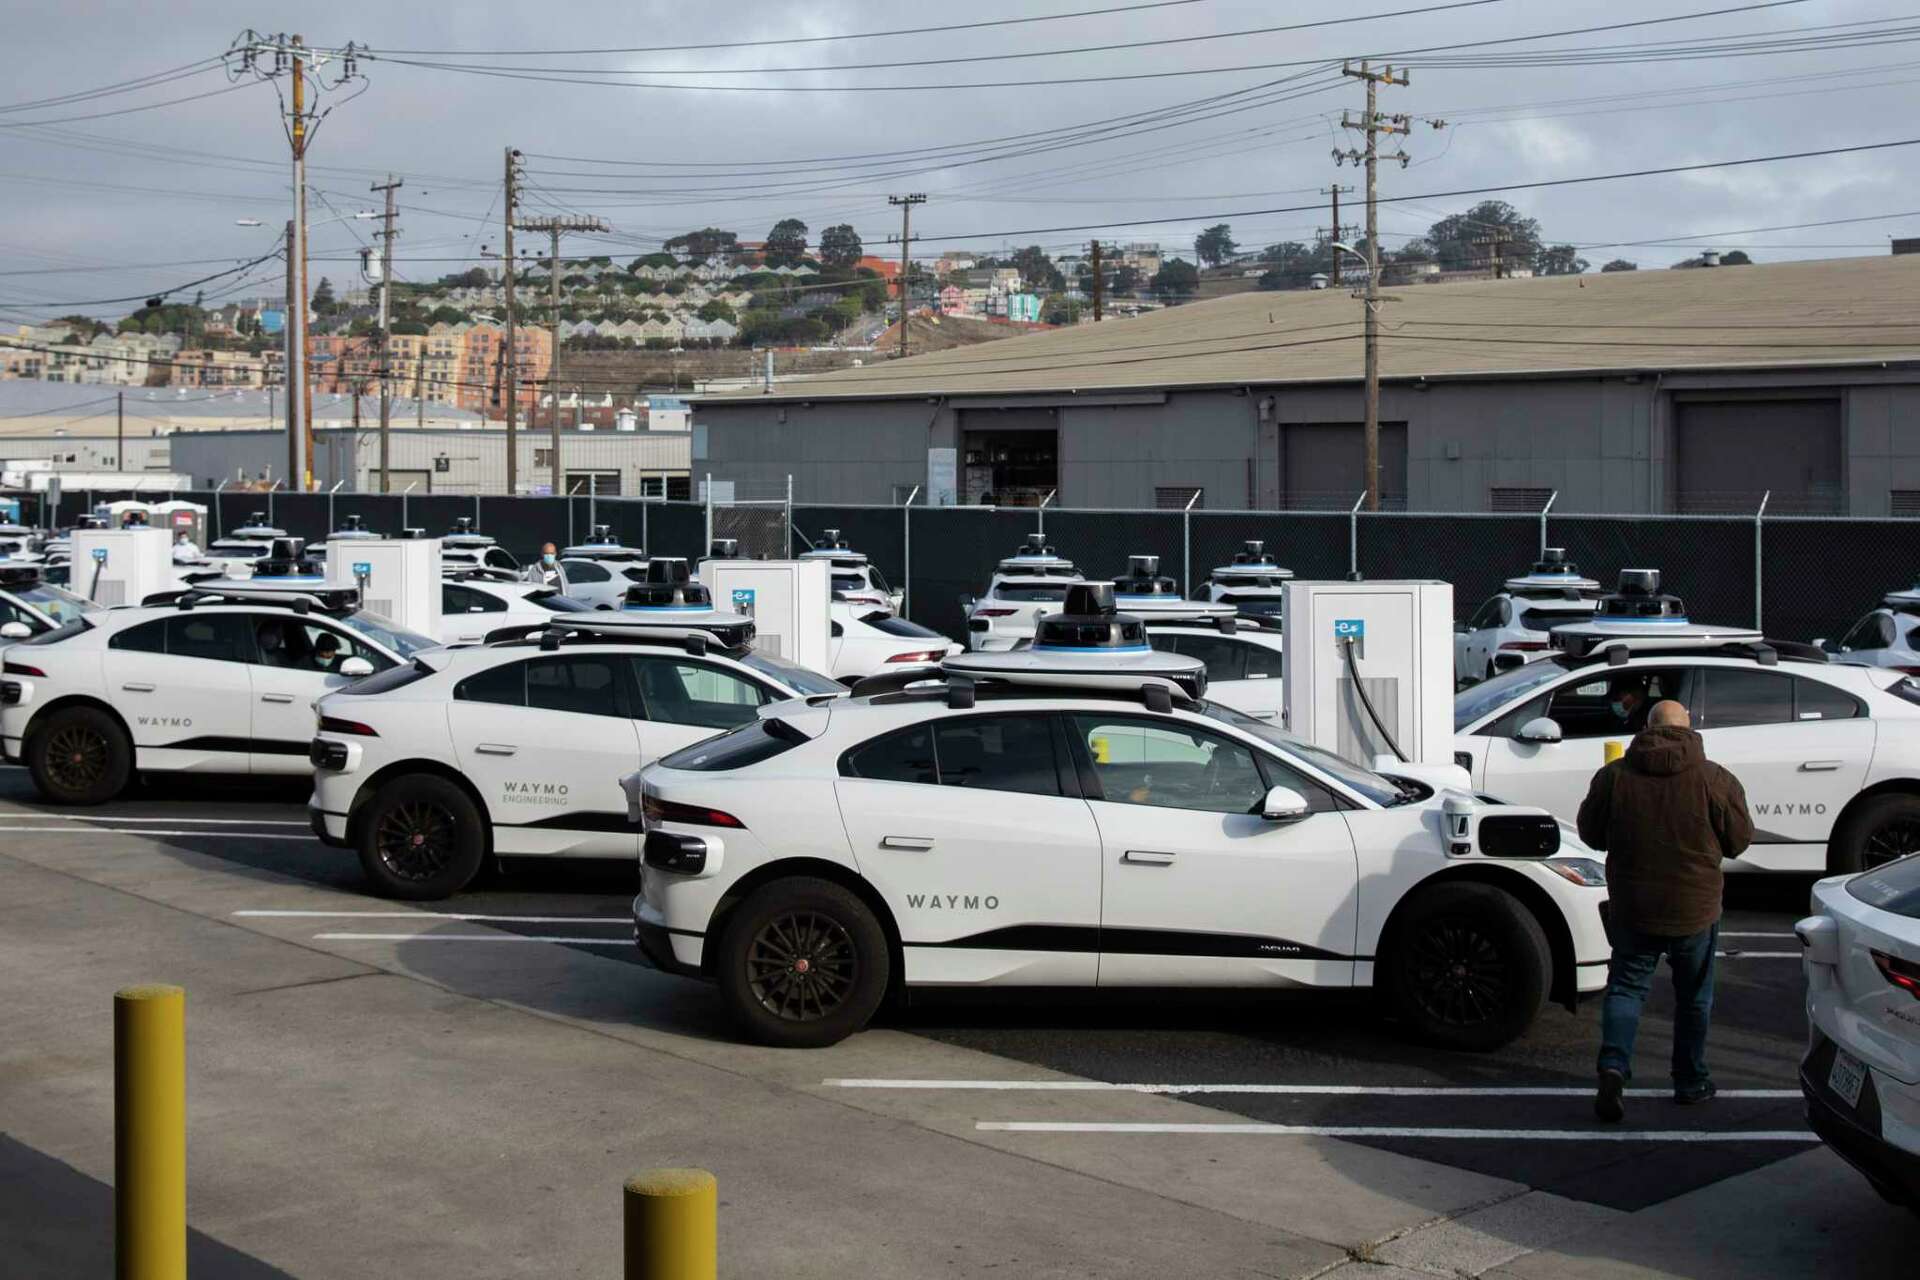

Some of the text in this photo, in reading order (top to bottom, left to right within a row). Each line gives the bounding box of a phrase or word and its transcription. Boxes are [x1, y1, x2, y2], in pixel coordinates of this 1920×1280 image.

[137, 717, 192, 727] WAYMO
[504, 782, 568, 795] WAYMO
[502, 794, 568, 806] ENGINEERING
[1755, 803, 1826, 815] WAYMO
[906, 894, 999, 910] WAYMO
